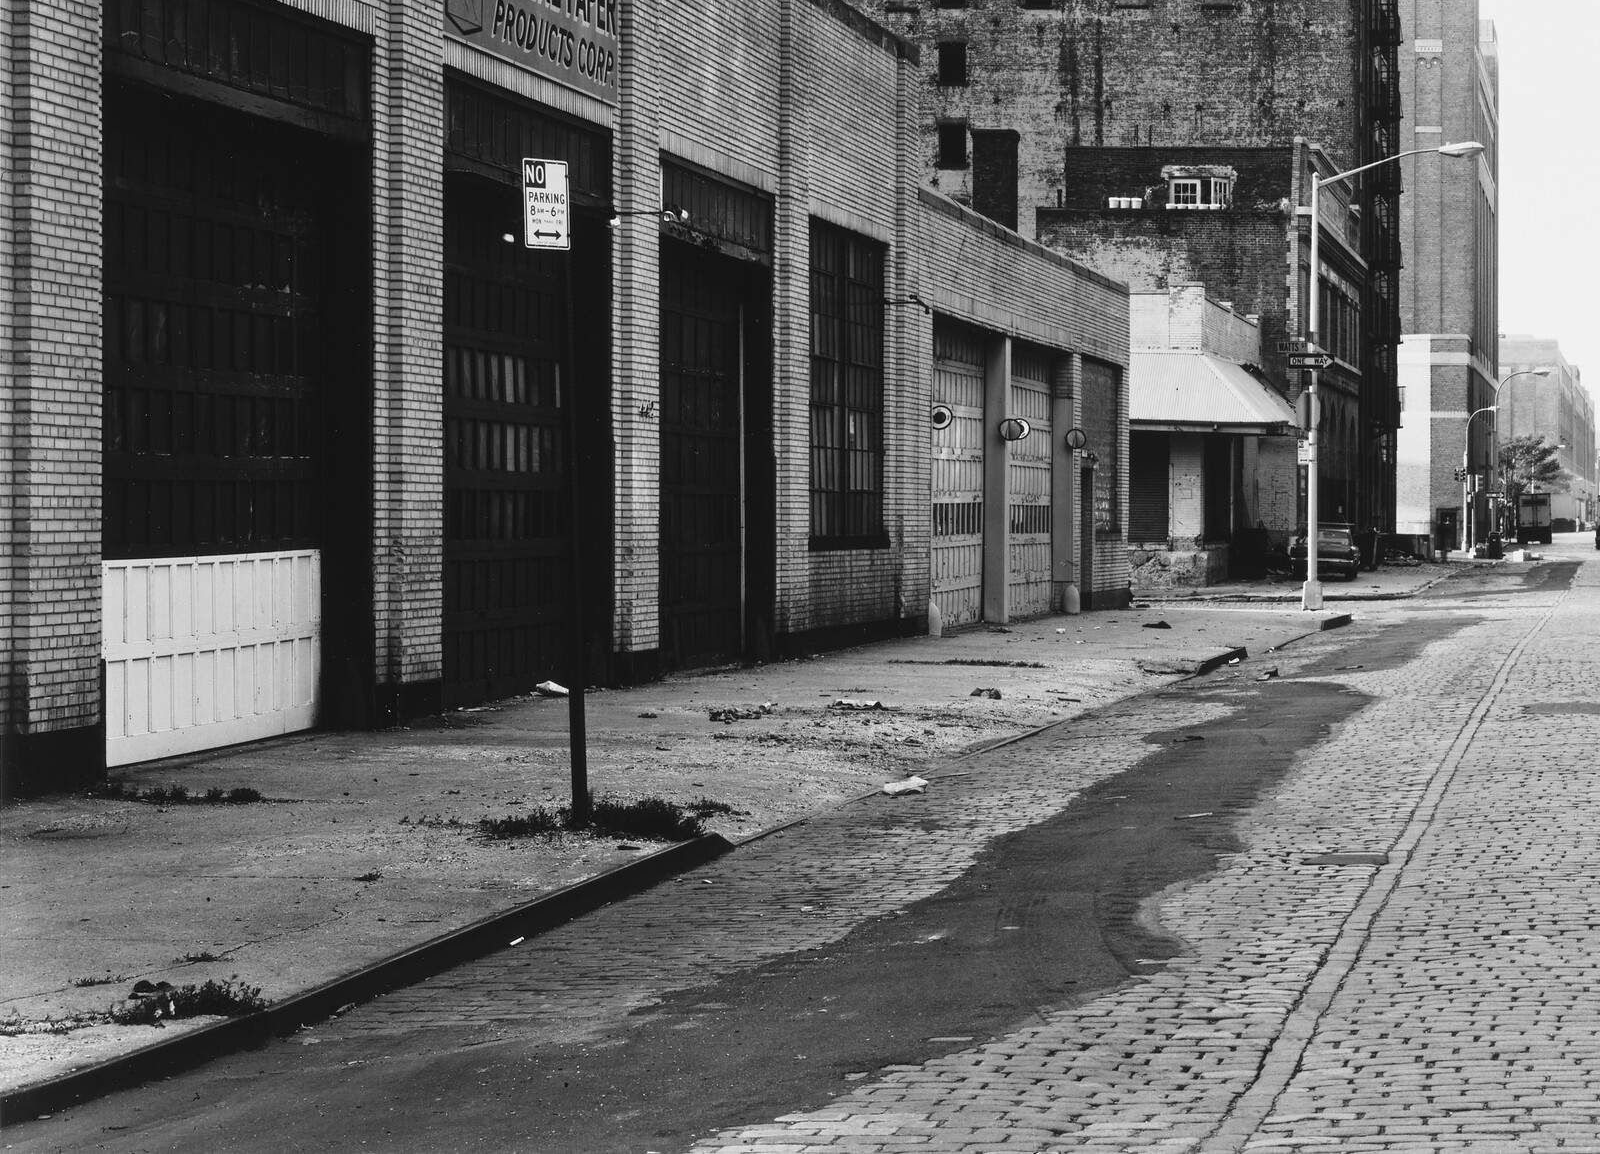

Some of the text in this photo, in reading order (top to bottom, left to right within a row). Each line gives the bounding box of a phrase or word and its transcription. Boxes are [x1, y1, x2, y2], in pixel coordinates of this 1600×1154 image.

[577, 37, 615, 89] CORP.
[526, 164, 545, 184] NO
[528, 191, 565, 205] PARKING
[1278, 342, 1299, 352] WATTS
[1292, 357, 1329, 365] ONE WAY
